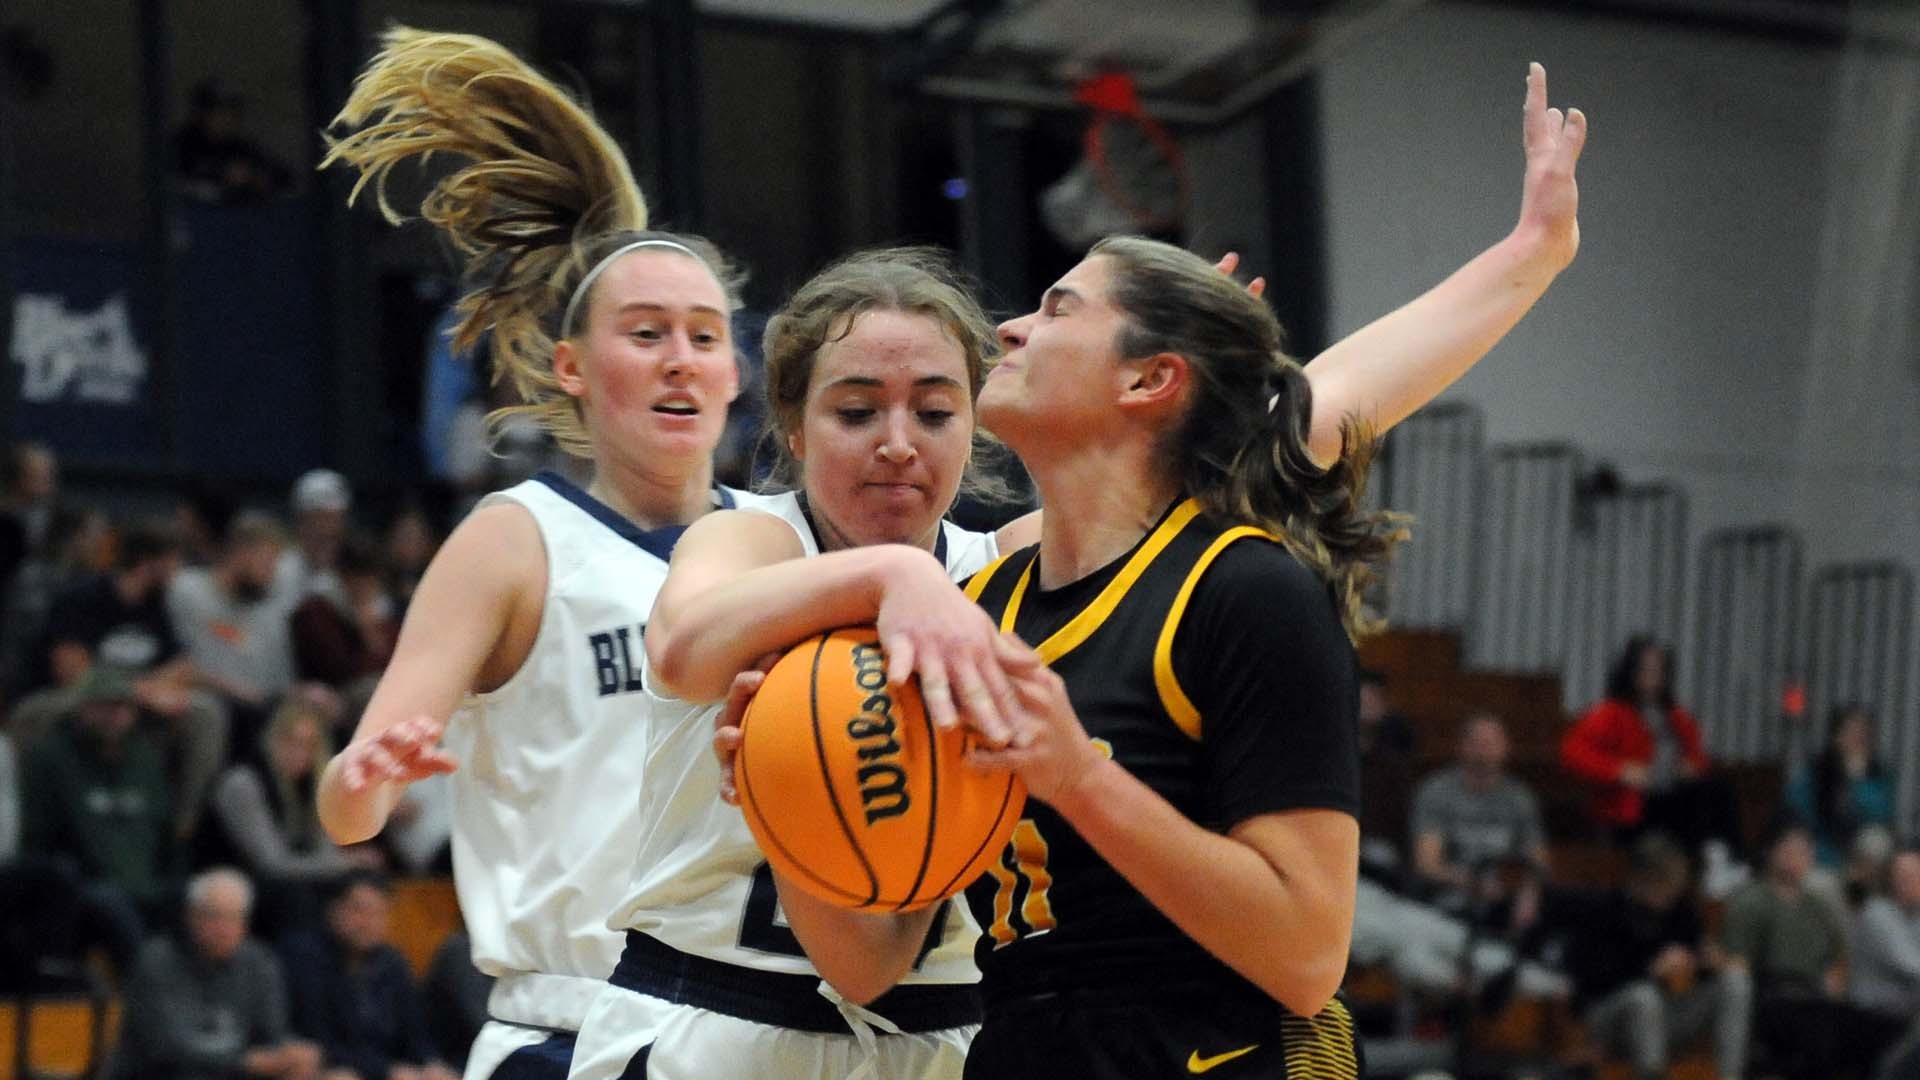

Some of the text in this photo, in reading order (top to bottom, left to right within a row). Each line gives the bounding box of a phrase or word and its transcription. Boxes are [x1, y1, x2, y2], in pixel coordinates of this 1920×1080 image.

[588, 623, 647, 696] BL
[847, 640, 912, 826] Wilson
[988, 818, 1057, 951] 11
